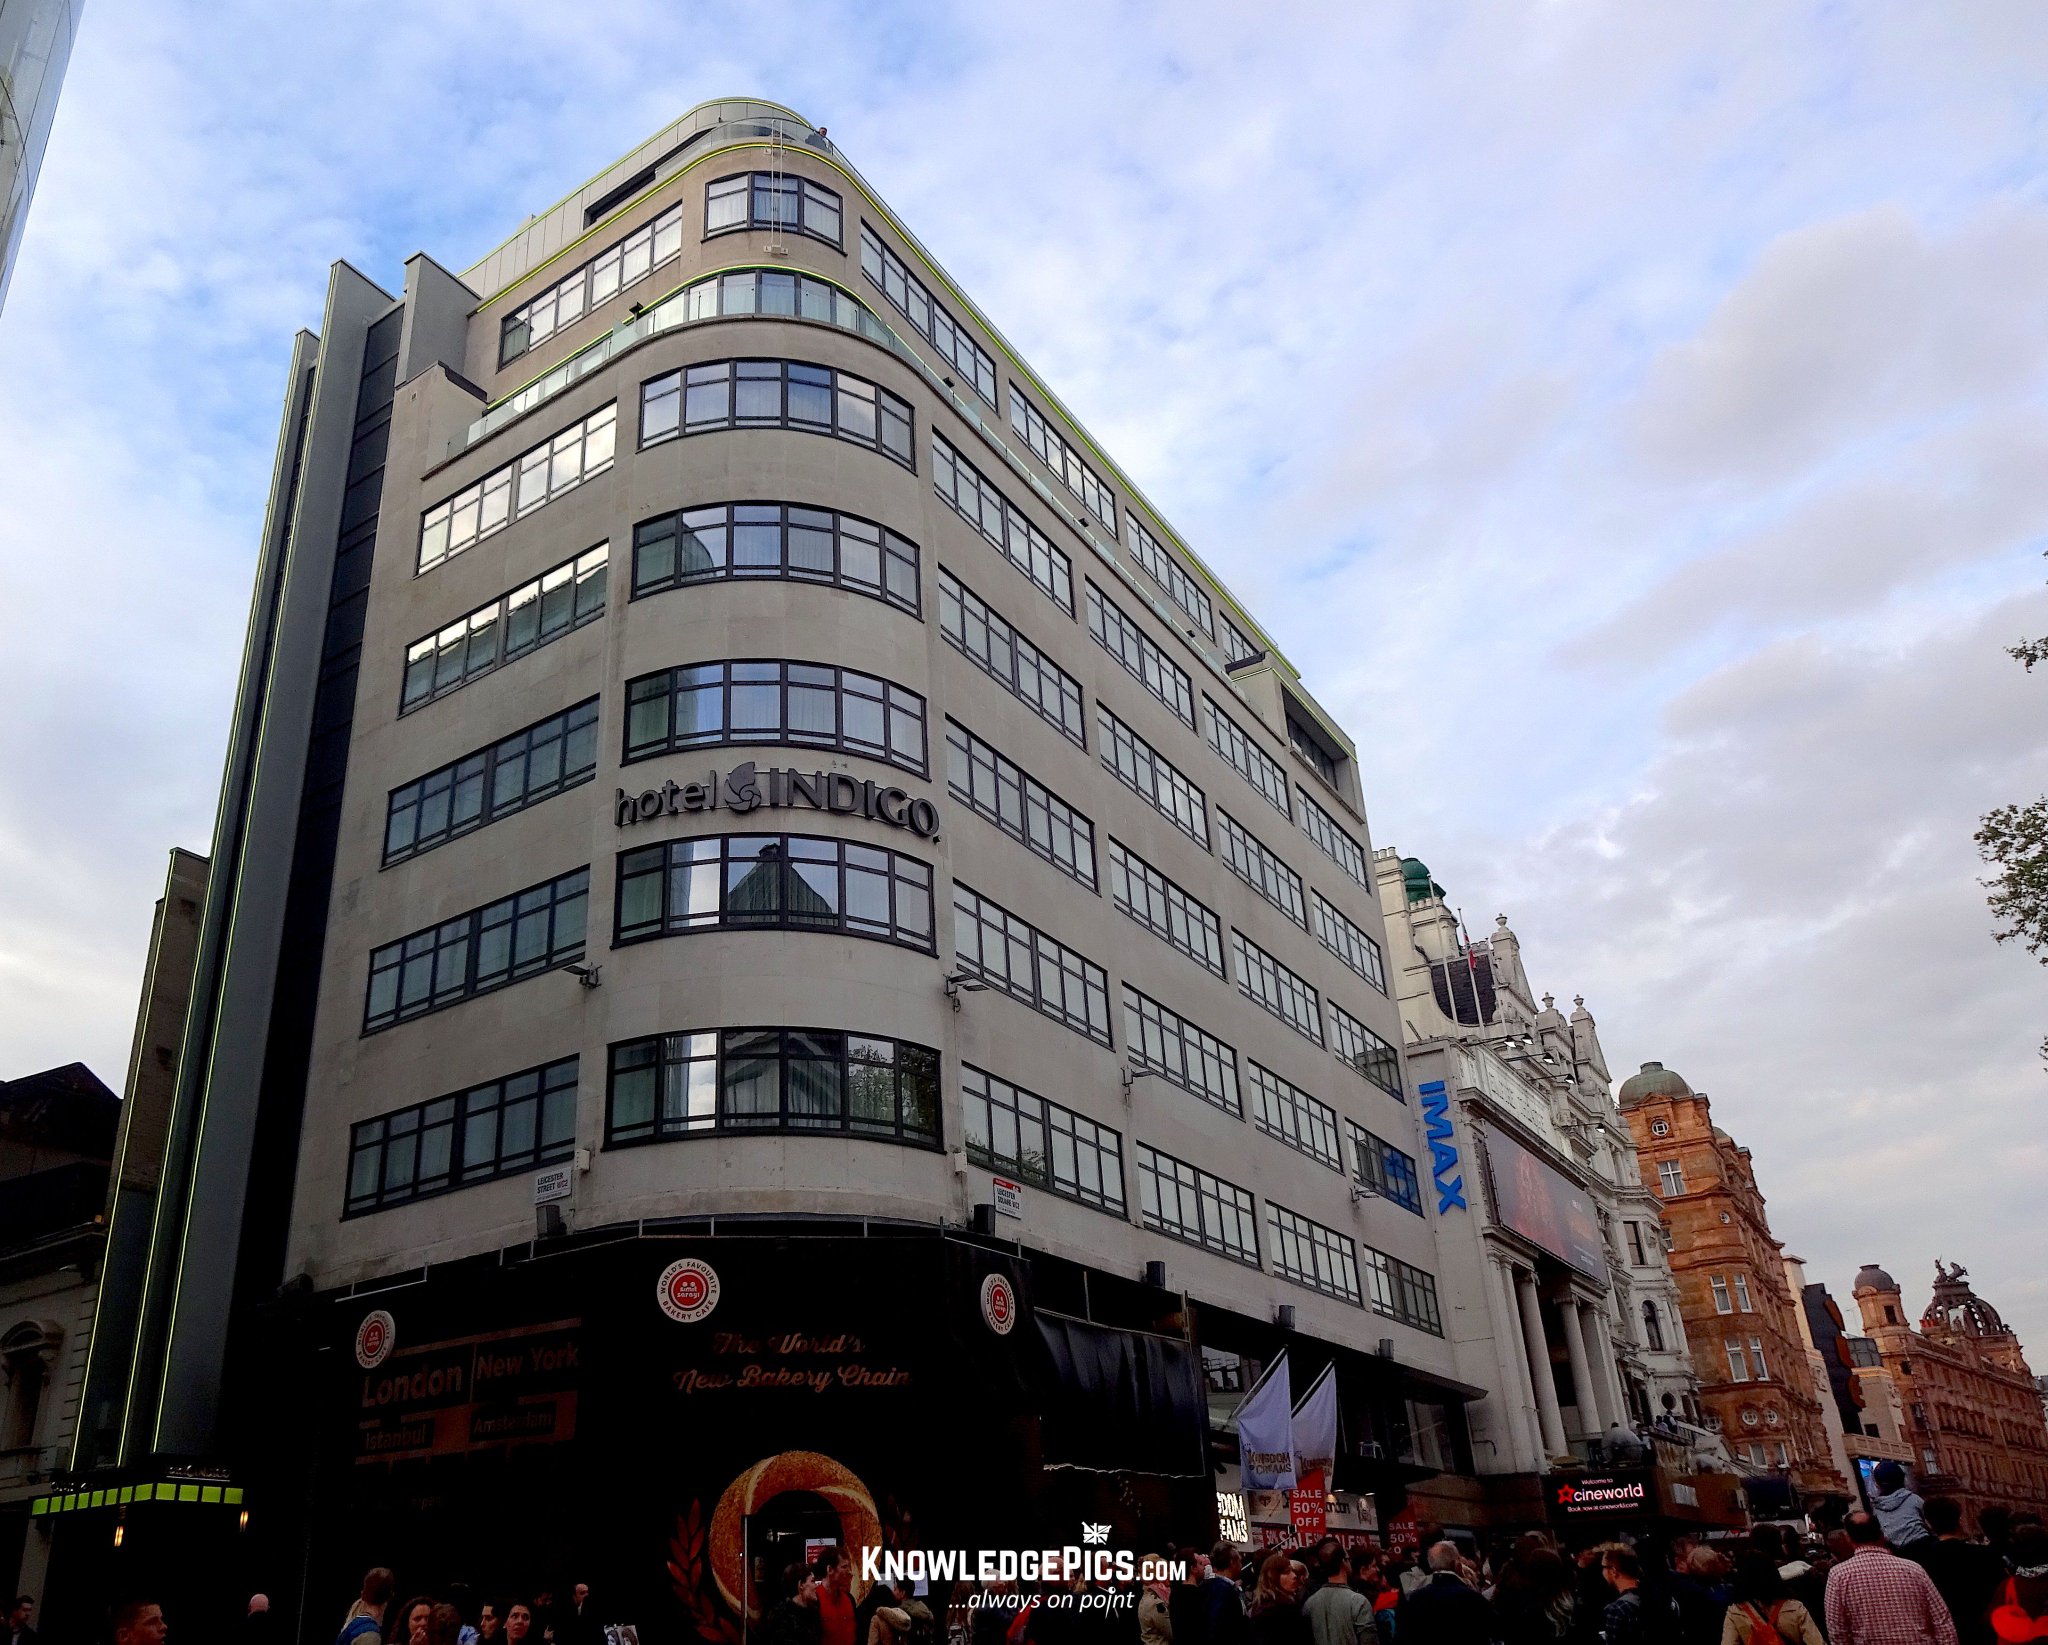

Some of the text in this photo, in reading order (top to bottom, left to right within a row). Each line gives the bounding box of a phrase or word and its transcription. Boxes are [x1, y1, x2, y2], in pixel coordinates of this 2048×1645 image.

[614, 767, 940, 838] hotel INDIGO
[1418, 1080, 1467, 1216] IMAX
[537, 1172, 564, 1186] LEICESTER
[537, 1182, 556, 1194] STREET
[996, 1187, 1016, 1200] LEICESTER
[660, 1261, 717, 1295] WORLD'S FAVOURITE
[662, 1299, 714, 1320] BAKERY CAFE
[476, 1340, 580, 1381] New York
[362, 1363, 463, 1409] London
[736, 1364, 834, 1393] Bakery
[836, 1363, 913, 1388] Chain
[365, 1424, 426, 1451] Istanbul
[1292, 1489, 1322, 1499] SALE
[1574, 1483, 1644, 1502] cineworld
[1292, 1502, 1324, 1514] 50%
[1295, 1516, 1320, 1527] OFF
[1388, 1521, 1416, 1530] SALE
[1390, 1533, 1417, 1543] 50%
